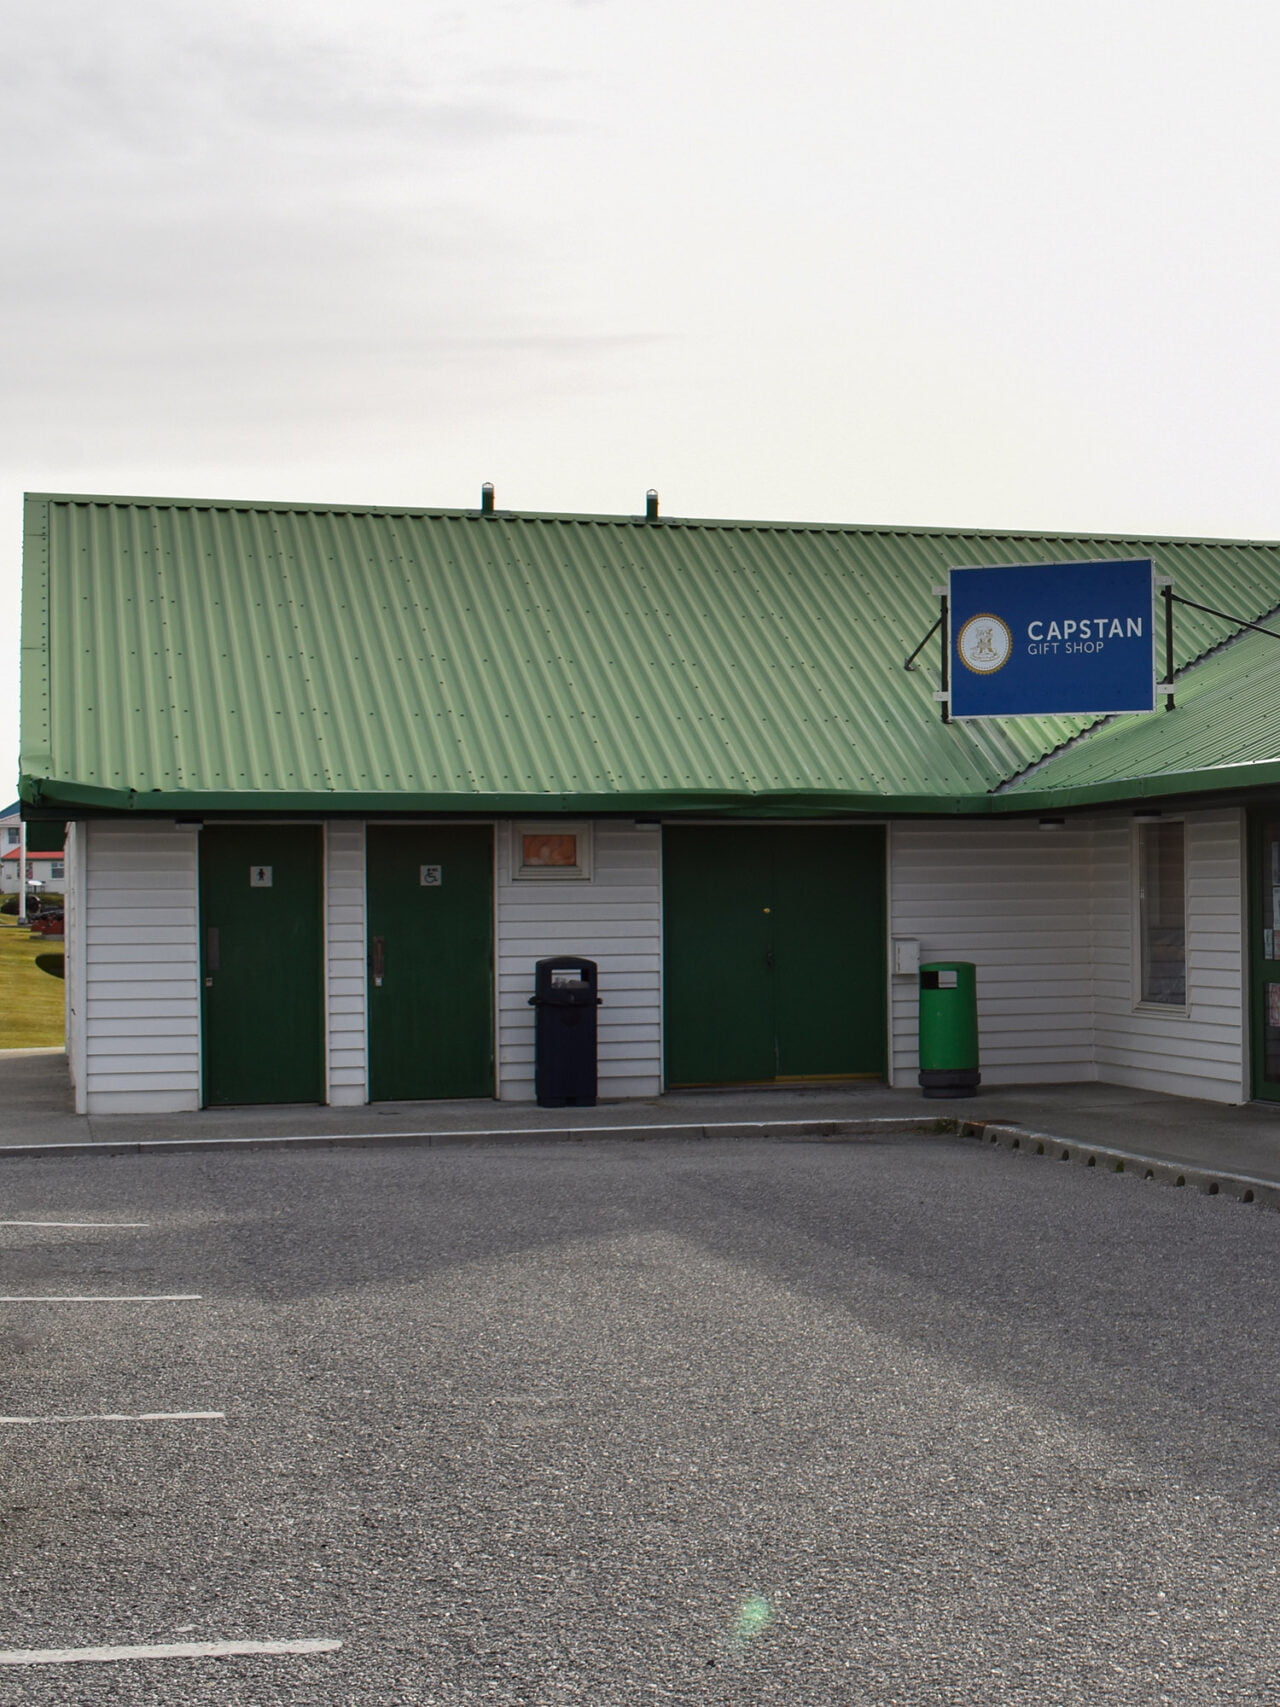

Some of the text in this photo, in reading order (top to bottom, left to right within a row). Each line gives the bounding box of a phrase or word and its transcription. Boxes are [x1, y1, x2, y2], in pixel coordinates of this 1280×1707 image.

[1027, 617, 1142, 641] CAPSTAN
[1027, 641, 1104, 655] GIFT SHOP
